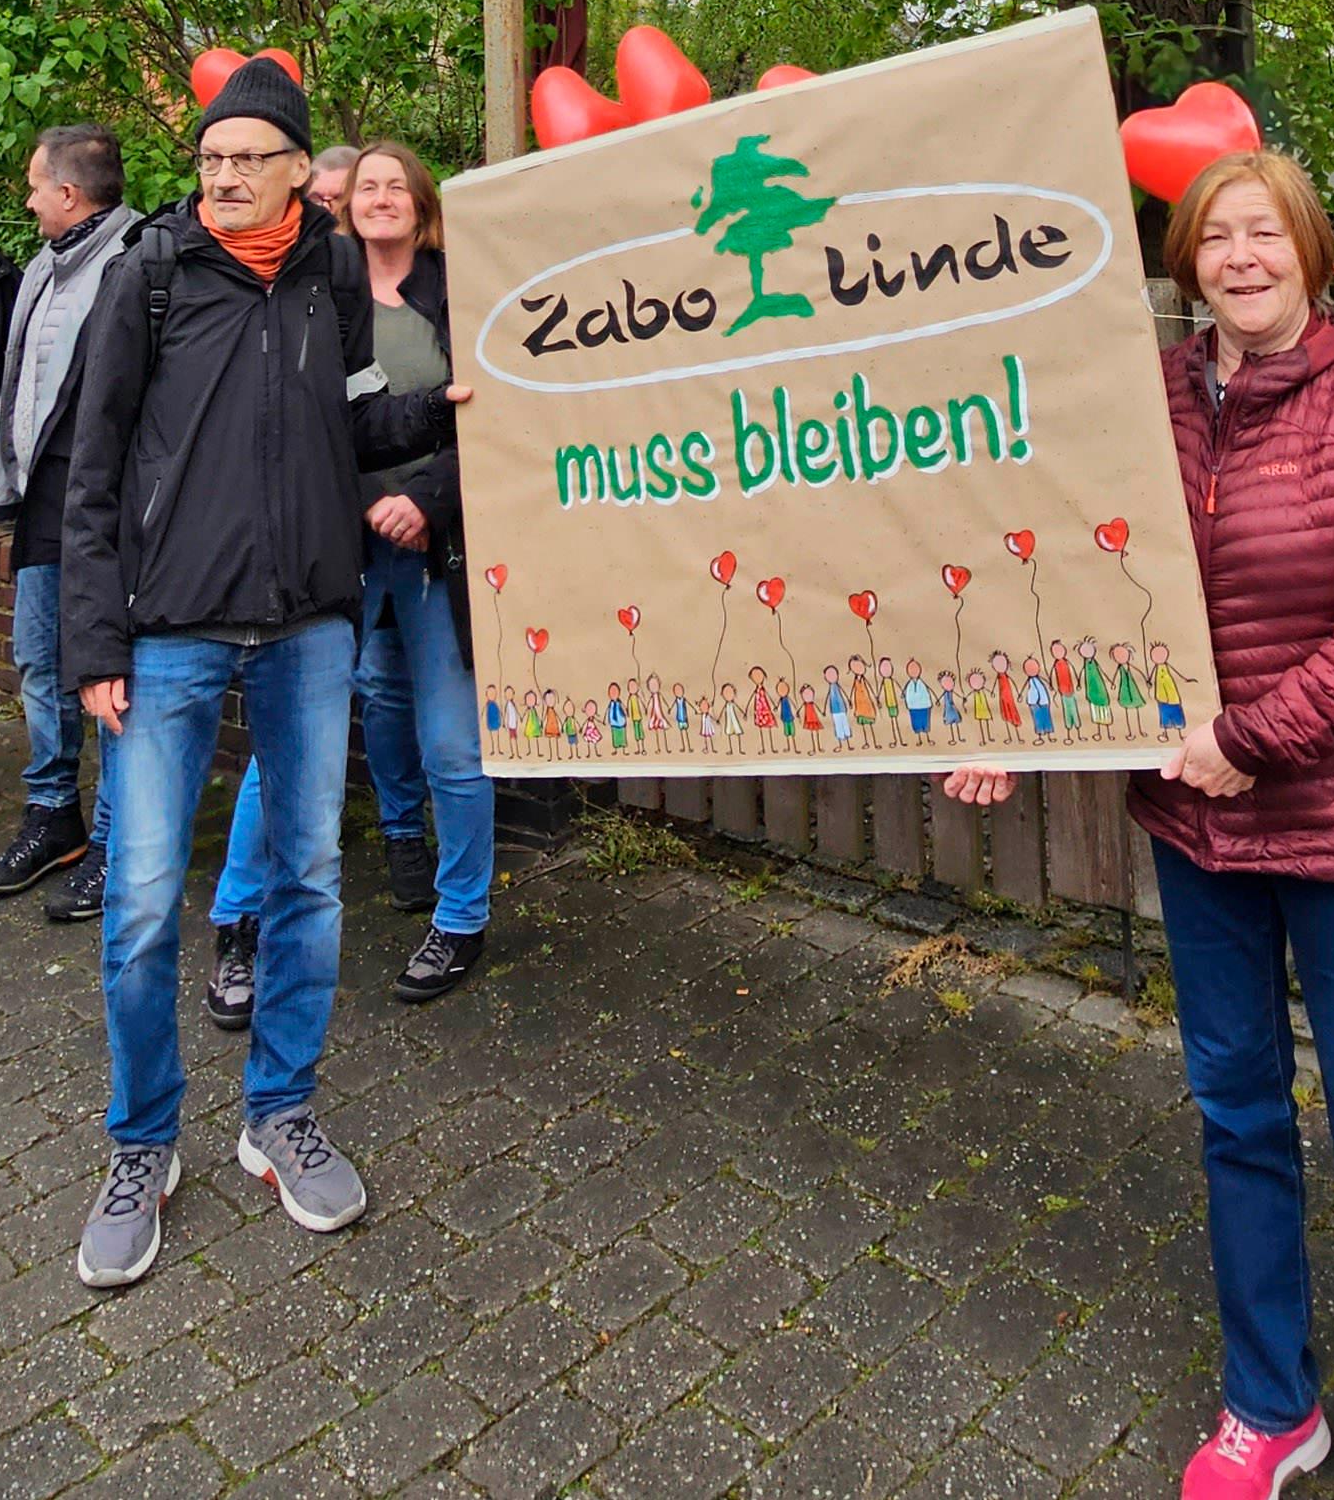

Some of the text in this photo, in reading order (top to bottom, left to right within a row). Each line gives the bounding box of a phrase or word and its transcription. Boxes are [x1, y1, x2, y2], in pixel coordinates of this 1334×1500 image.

[520, 213, 1073, 358] Zabo Linde
[555, 354, 1034, 510] muss bleiben!
[1271, 461, 1298, 477] Rab
